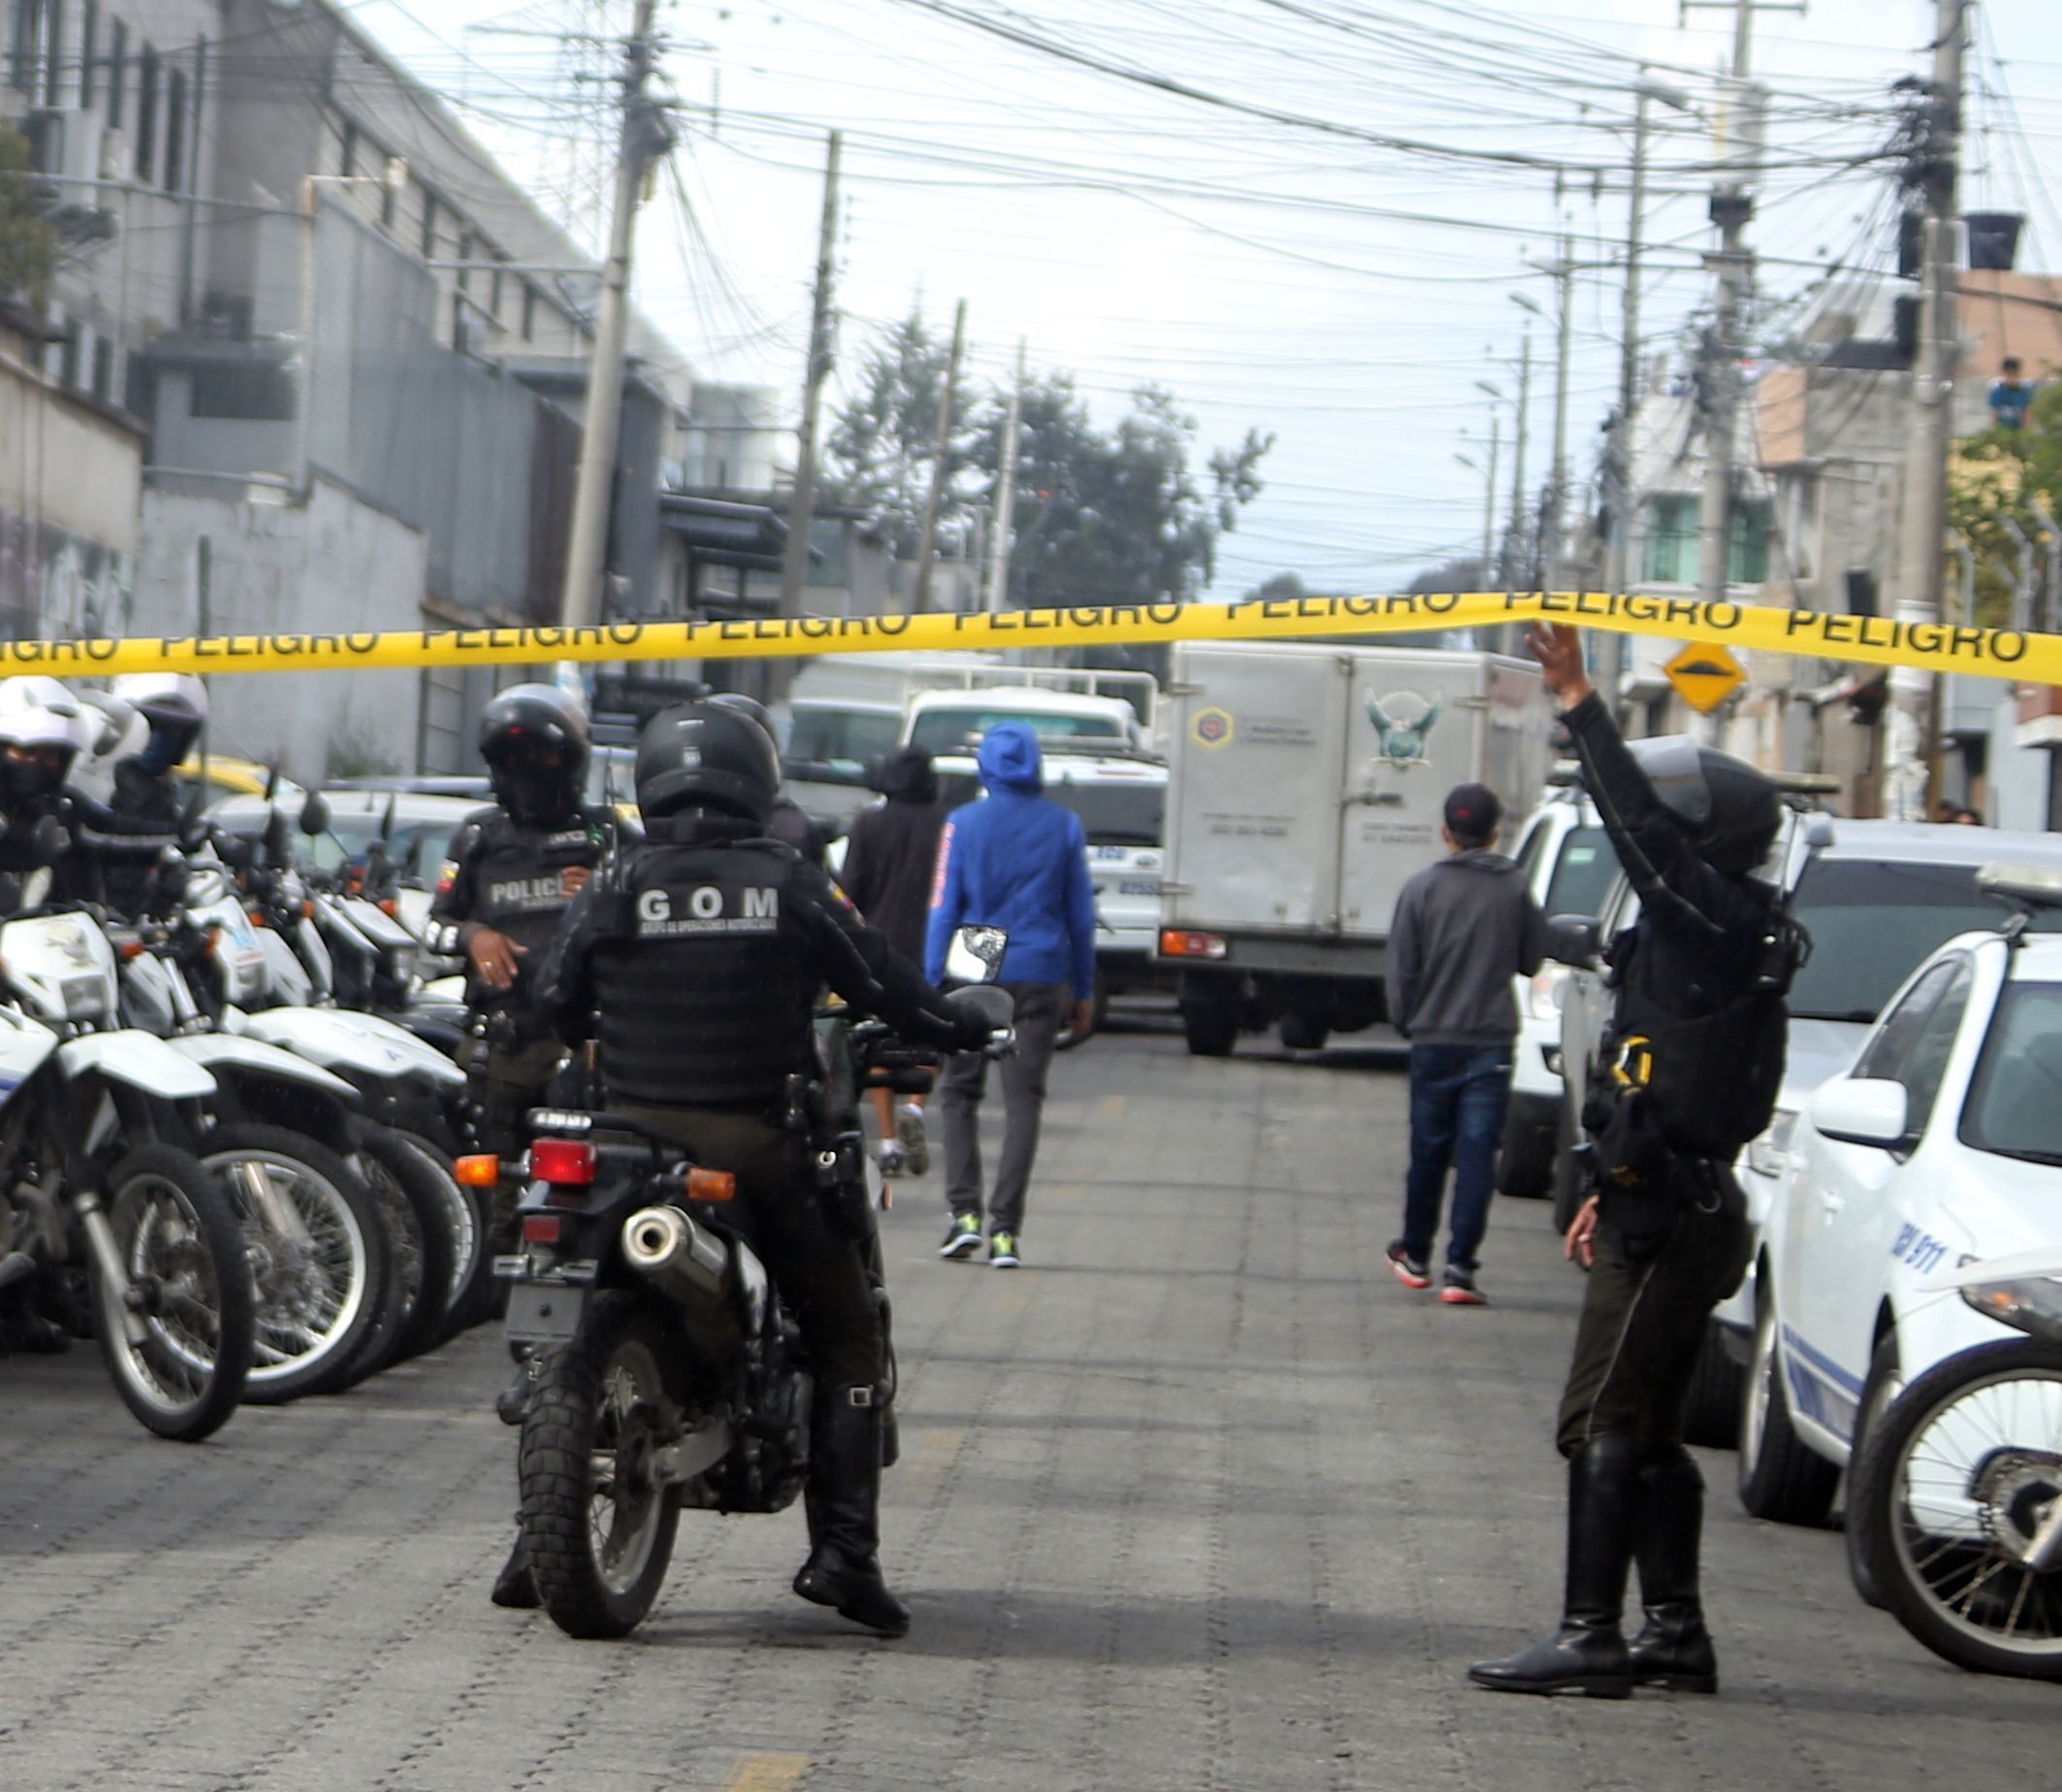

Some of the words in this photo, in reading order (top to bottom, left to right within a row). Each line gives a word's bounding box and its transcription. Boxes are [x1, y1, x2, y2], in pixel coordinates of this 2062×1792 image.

[160, 633, 378, 657] PELIGRO
[421, 623, 644, 650] PELIGRO
[686, 614, 911, 641] PELIGRO
[954, 604, 1183, 630] PELIGRO
[1227, 593, 1461, 620] PELIGRO
[1504, 592, 1744, 629] PELIGRO
[1786, 609, 2028, 662] PELIGRO
[490, 877, 564, 904] POLICI
